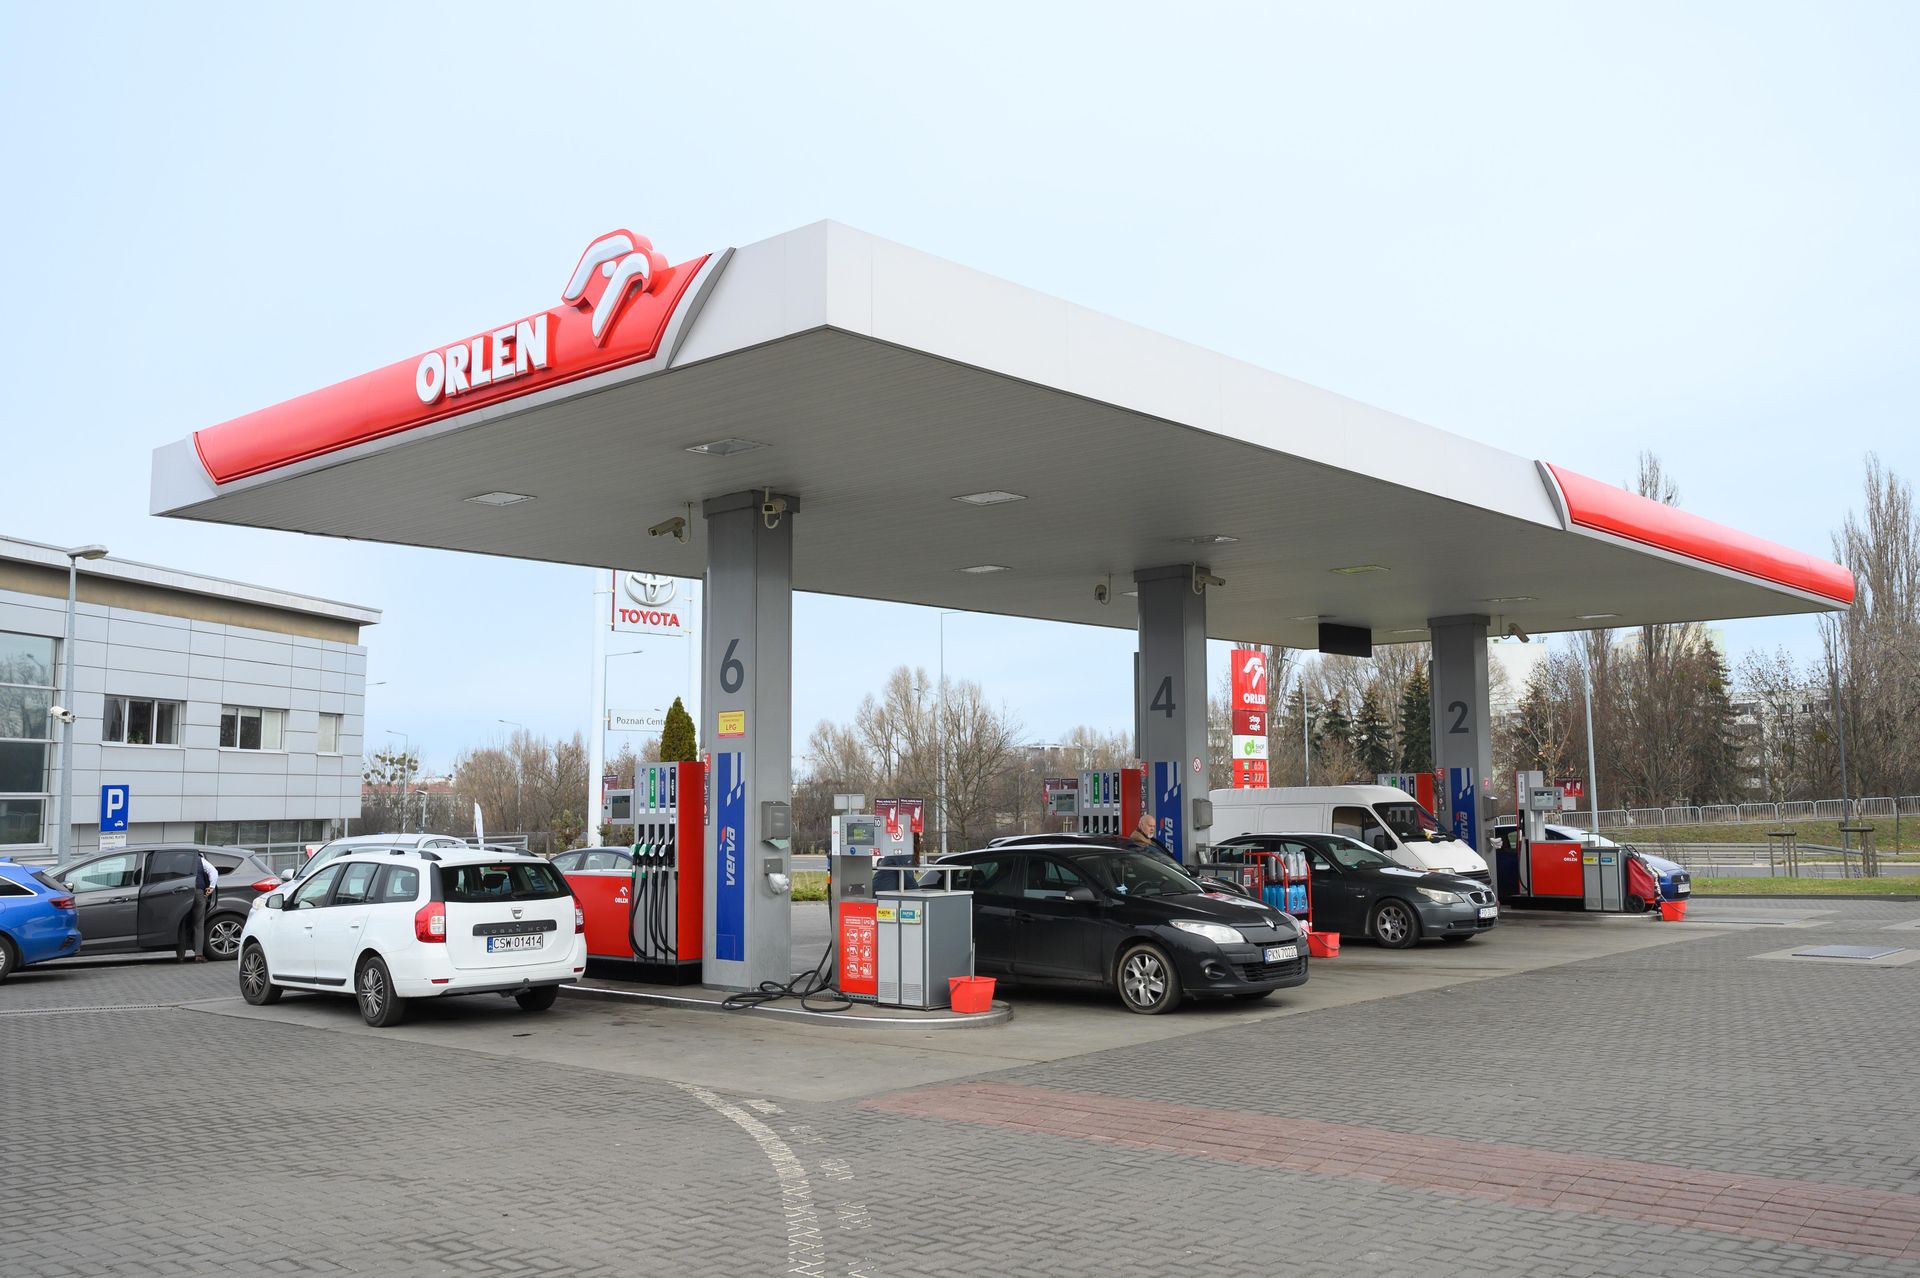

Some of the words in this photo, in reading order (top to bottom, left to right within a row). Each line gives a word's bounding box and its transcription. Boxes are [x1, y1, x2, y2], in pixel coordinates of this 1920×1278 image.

[415, 312, 549, 405] ORLEN
[618, 608, 680, 627] TOYOTA
[719, 638, 745, 694] 6
[1150, 675, 1176, 719] 4
[1243, 692, 1266, 705] ORLEN
[646, 717, 666, 726] Cent
[725, 723, 737, 731] LPG
[1448, 700, 1470, 735] 2
[107, 789, 123, 818] P
[874, 818, 881, 827] 10
[1164, 816, 1174, 854] erva
[1460, 810, 1469, 845] erva
[725, 826, 736, 886] verva
[494, 937, 511, 948] CSW
[514, 936, 542, 947] 01414
